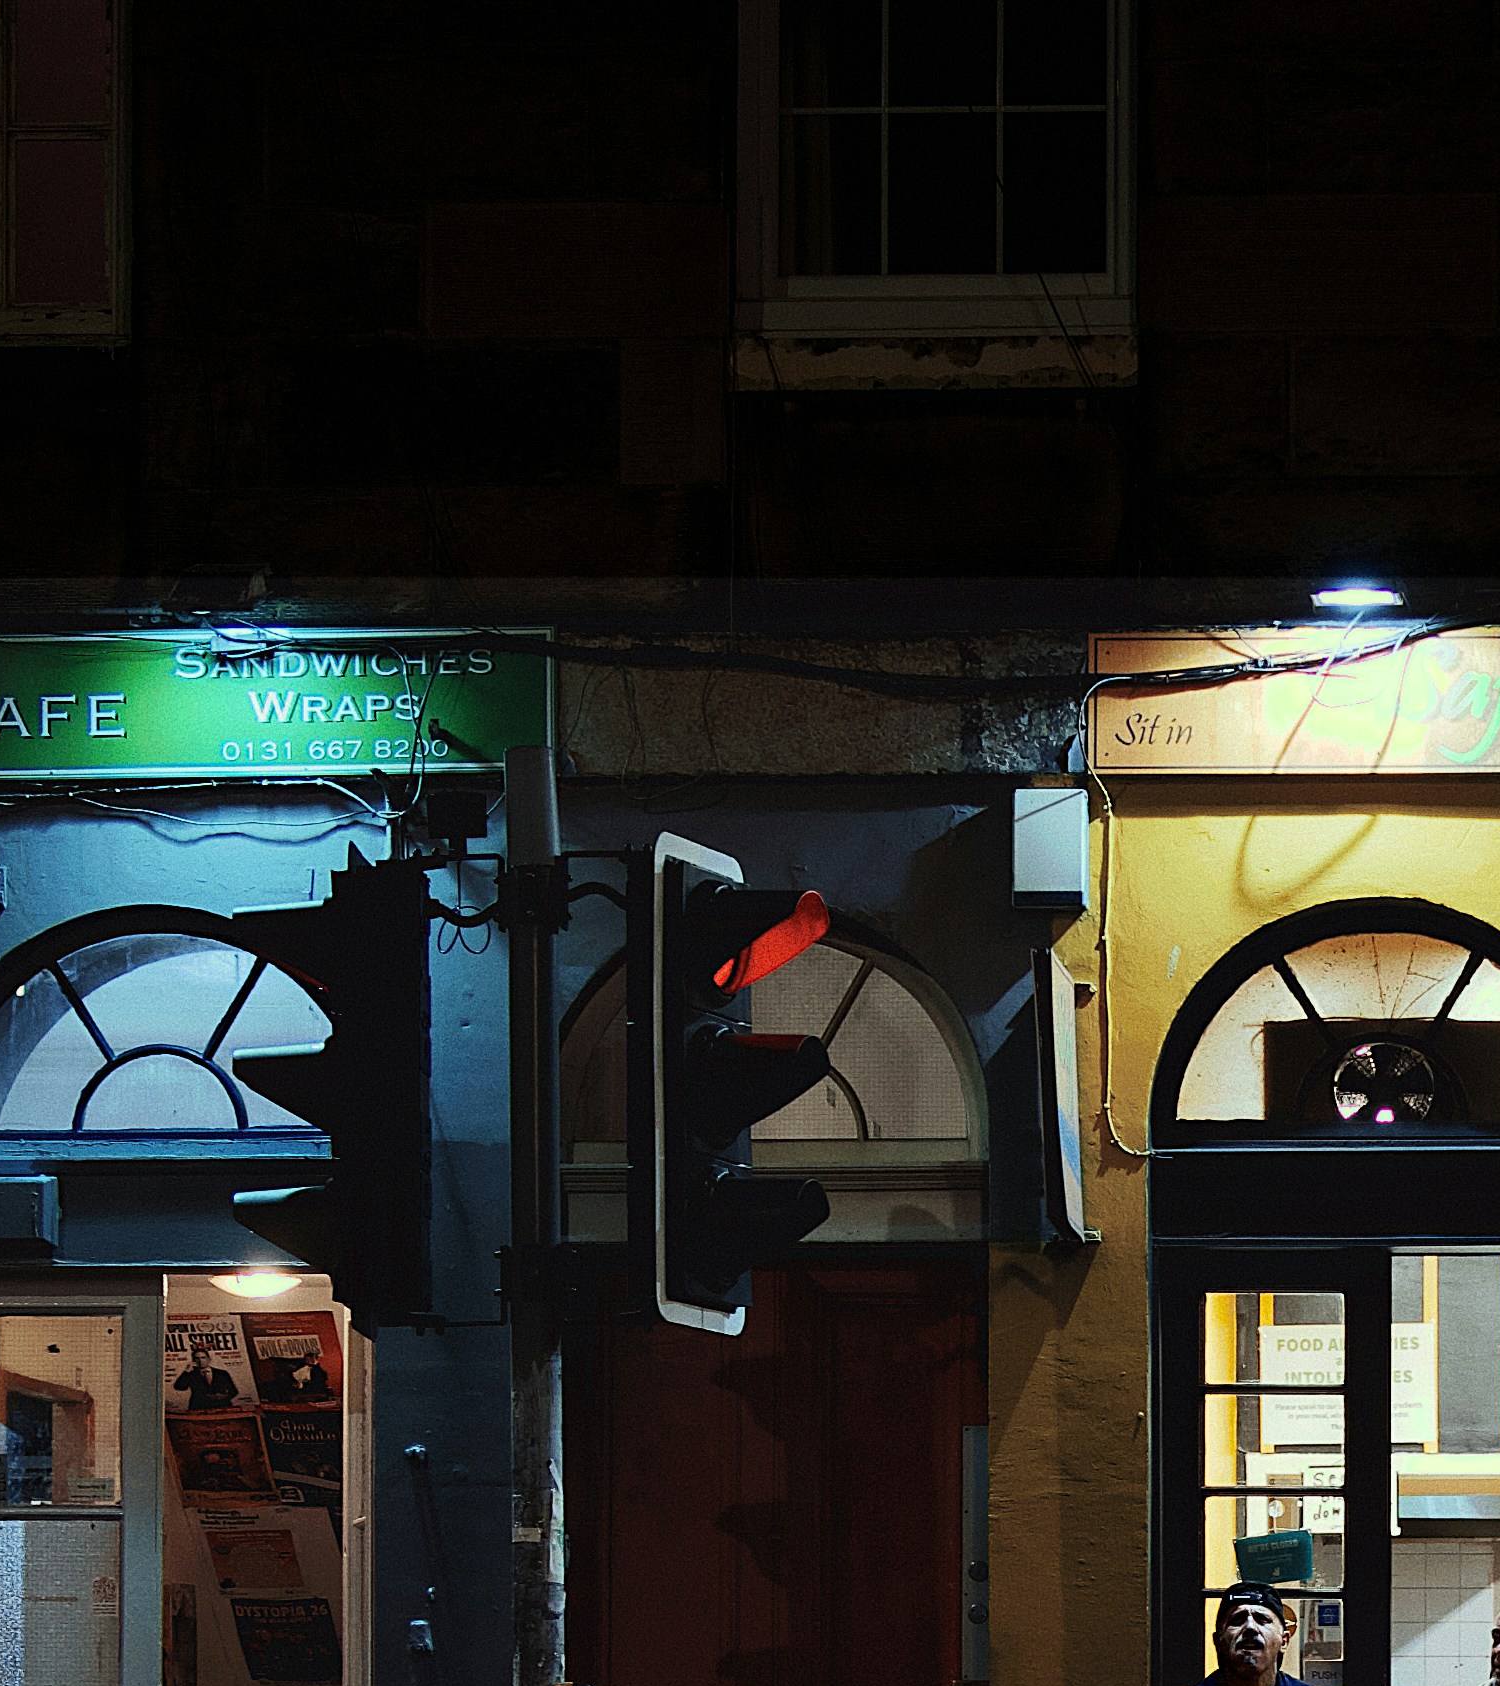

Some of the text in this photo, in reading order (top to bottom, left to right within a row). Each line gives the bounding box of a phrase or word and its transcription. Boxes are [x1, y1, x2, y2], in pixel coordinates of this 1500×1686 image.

[174, 649, 496, 679] SANDWICHES
[247, 691, 425, 723] WRAPS
[1114, 711, 1193, 747] Sit in
[221, 739, 294, 762] 0131
[308, 739, 365, 761] 667
[165, 1332, 238, 1352] ALL STREET
[1277, 1339, 1324, 1351] FOOD
[280, 1419, 316, 1431] Don
[1311, 1670, 1338, 1680] PUSH
